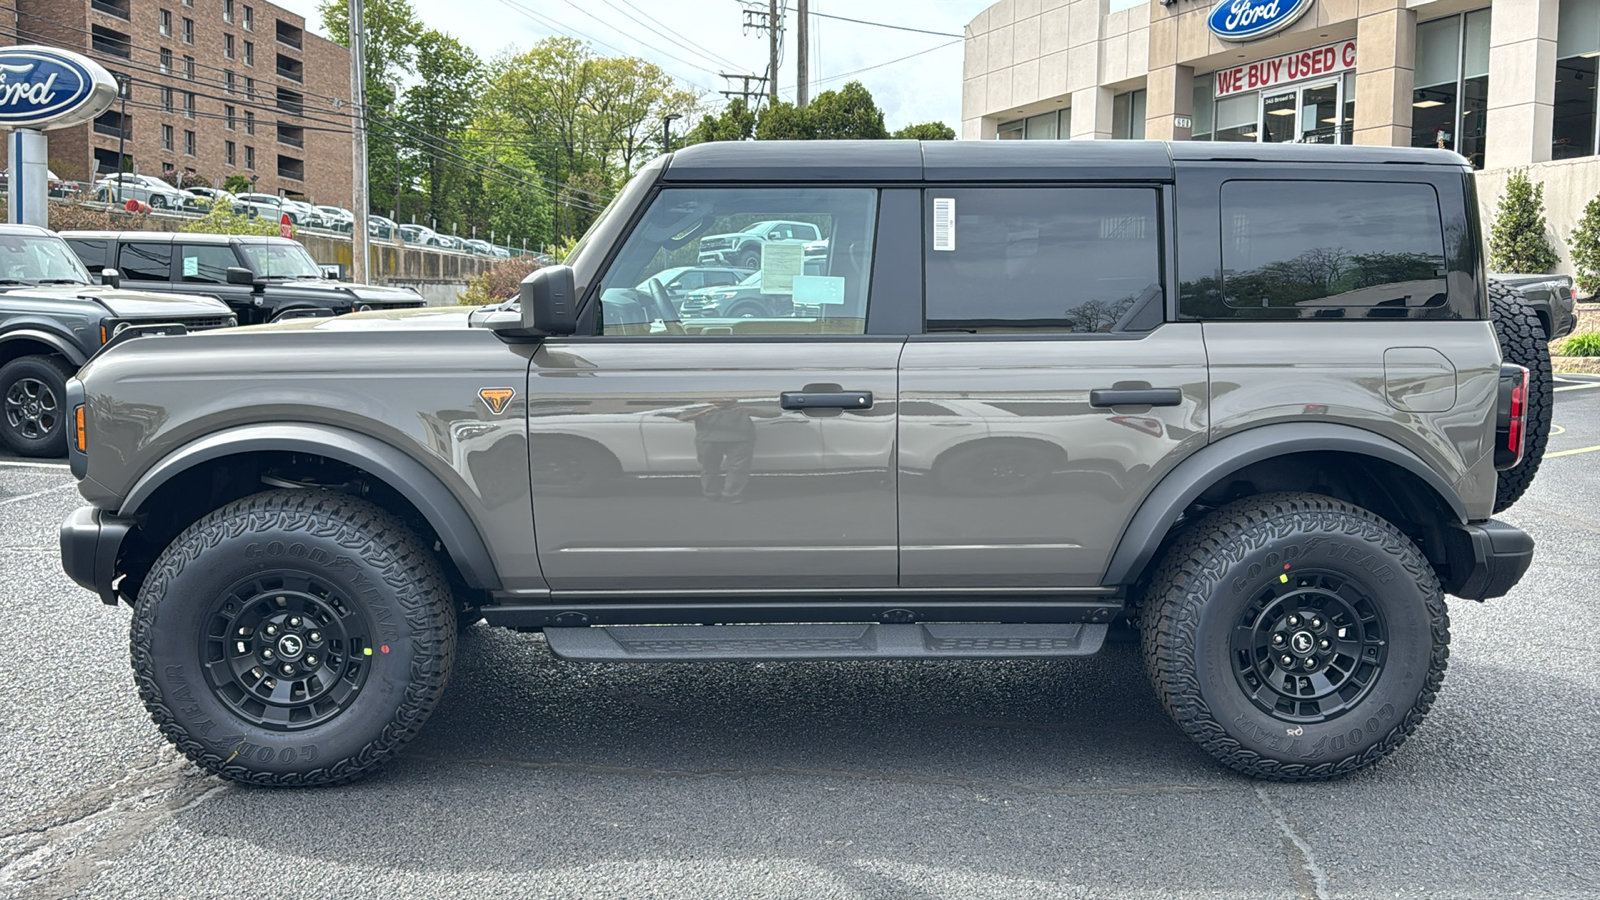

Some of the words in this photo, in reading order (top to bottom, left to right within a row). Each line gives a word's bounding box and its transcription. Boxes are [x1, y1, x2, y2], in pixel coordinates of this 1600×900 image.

[1225, 0, 1281, 30] Ford
[1217, 68, 1243, 94] WE
[1248, 58, 1283, 88] BUY
[1287, 47, 1336, 80] USED
[1342, 42, 1356, 67] C
